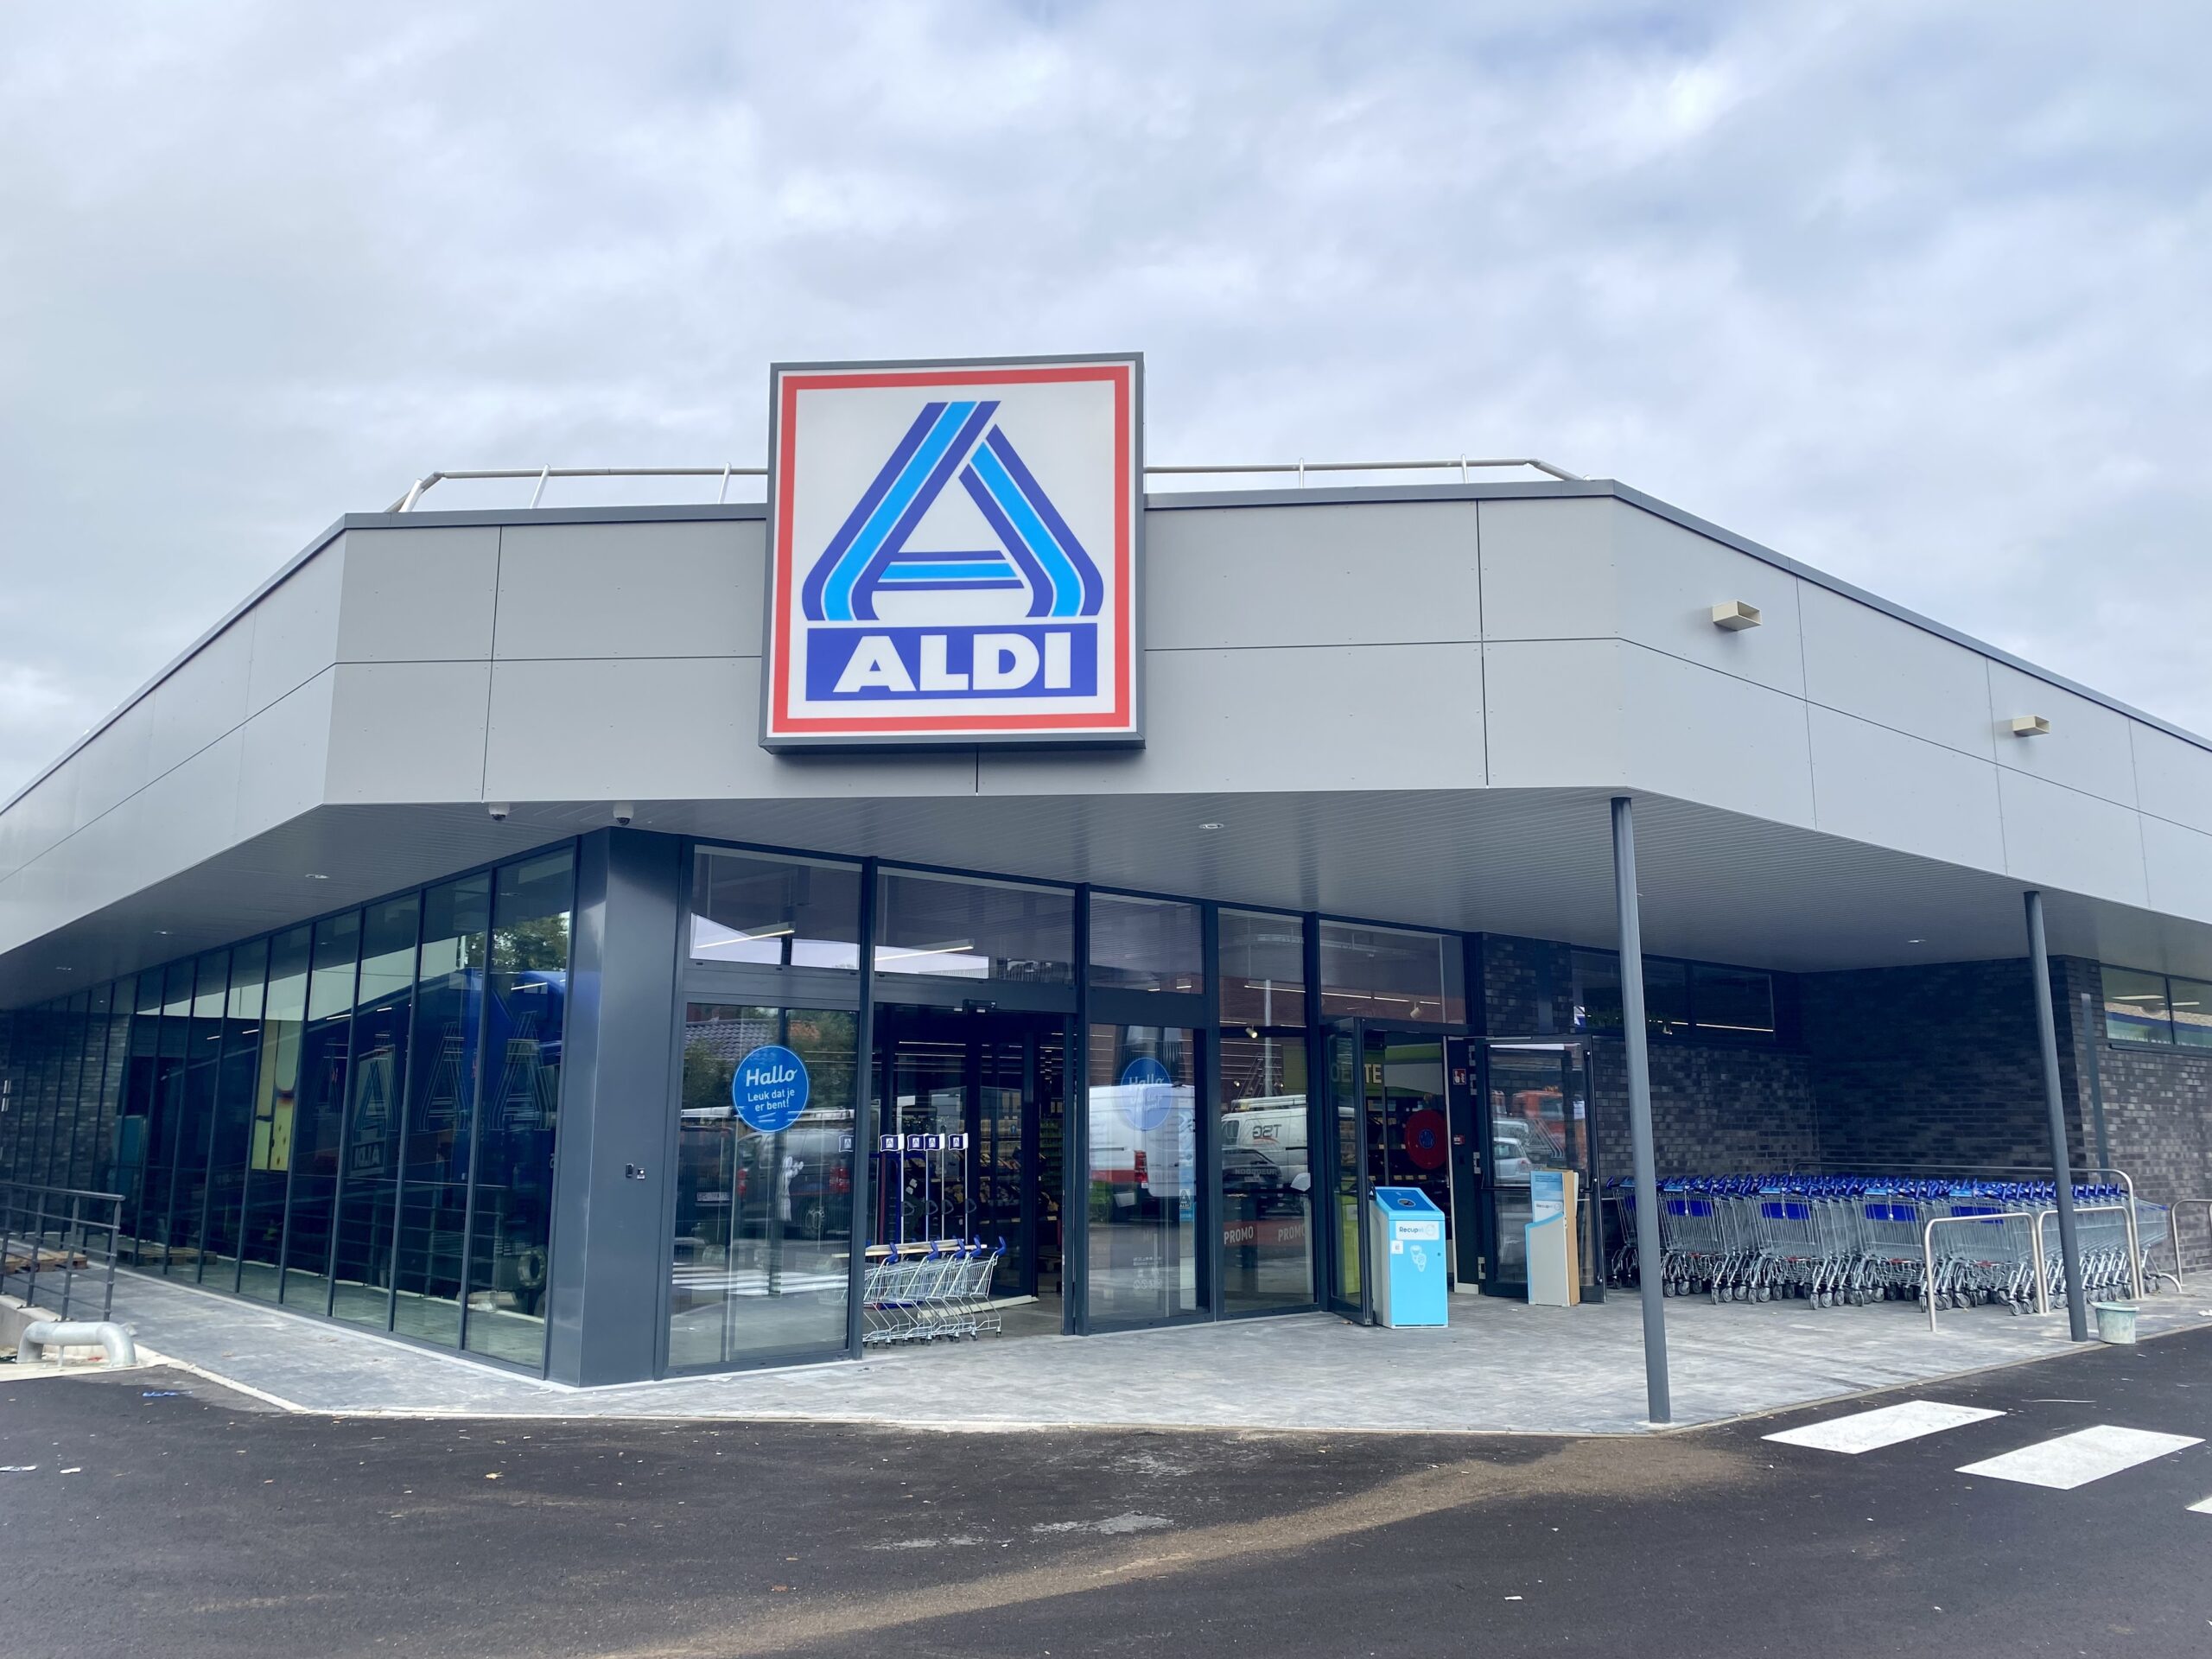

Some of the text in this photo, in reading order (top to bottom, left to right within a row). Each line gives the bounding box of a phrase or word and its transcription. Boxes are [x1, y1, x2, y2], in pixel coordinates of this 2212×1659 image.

[832, 632, 1071, 693] ALDI
[746, 1065, 798, 1086] Hallo
[747, 1087, 795, 1103] Leuk dat je
[754, 1097, 790, 1112] er bent!
[1224, 1225, 1254, 1245] PROMO
